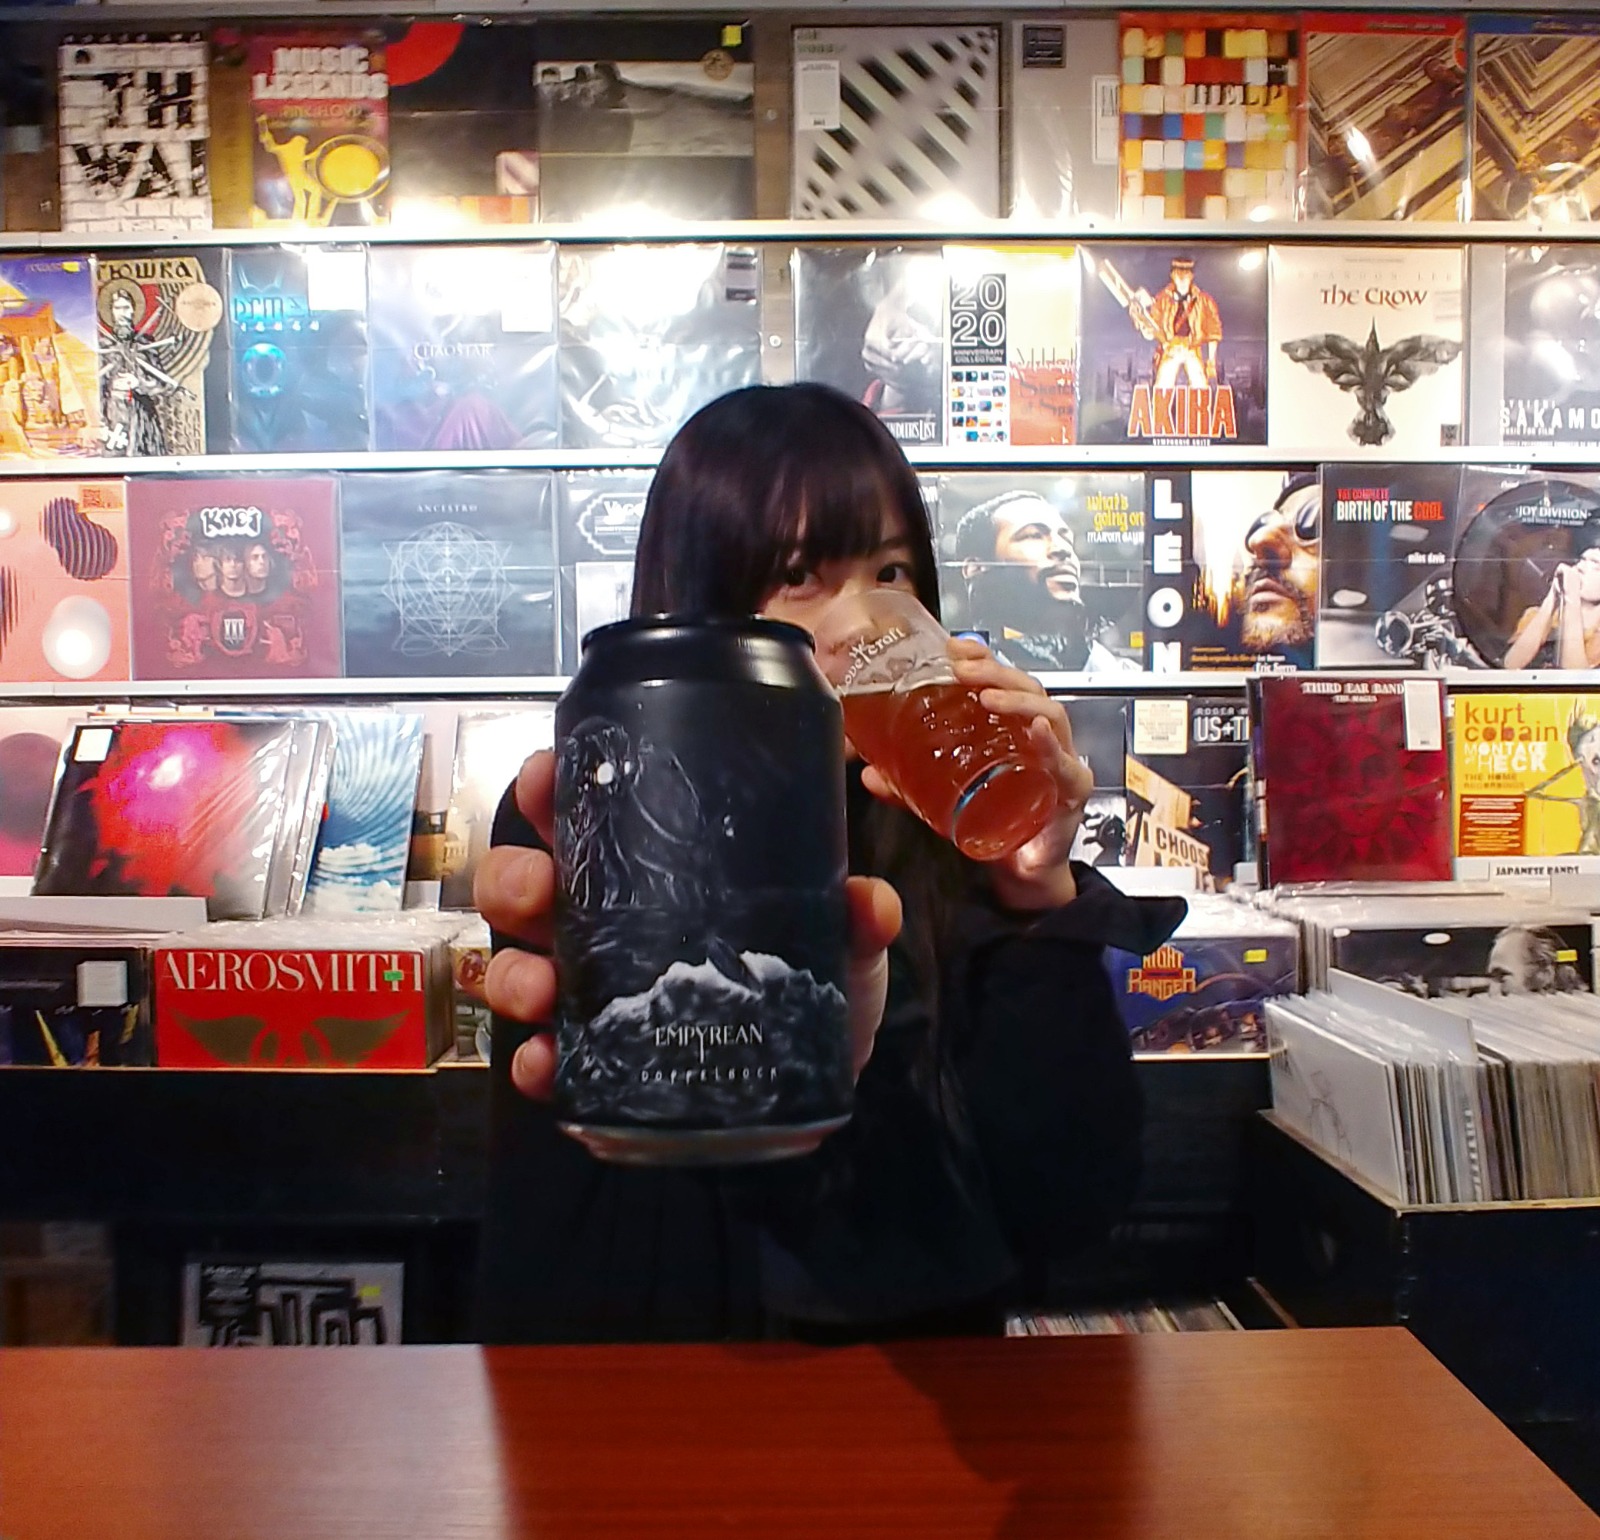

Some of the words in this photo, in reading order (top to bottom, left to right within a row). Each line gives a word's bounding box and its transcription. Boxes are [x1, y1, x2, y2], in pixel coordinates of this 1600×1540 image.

[272, 47, 369, 73] MUSIC
[252, 73, 388, 99] LEGENDS
[1365, 287, 1428, 311] CROW
[951, 312, 1007, 347] 20
[1127, 384, 1238, 438] AKIRA
[1500, 407, 1600, 430] SAKAMO
[1094, 509, 1128, 532] going
[1129, 511, 1144, 527] on
[1336, 500, 1371, 521] BIRTH
[1373, 500, 1388, 521] OF
[1389, 500, 1412, 521] THE
[1413, 501, 1444, 521] COOL
[1518, 505, 1537, 517] JOY
[1539, 507, 1589, 519] DIVISION
[1301, 682, 1342, 694] THIRD
[1344, 683, 1370, 694] EAR
[1371, 683, 1404, 695] BAND
[1196, 707, 1235, 716] ROGER
[1464, 701, 1526, 725] kurt
[1464, 720, 1558, 742] cobain
[1478, 754, 1547, 773] HECK
[1496, 866, 1545, 876] JAPANESE
[162, 951, 424, 993] AEROSMITH
[1127, 967, 1197, 1001] RANGER
[655, 1023, 764, 1064] EMPYREAN
